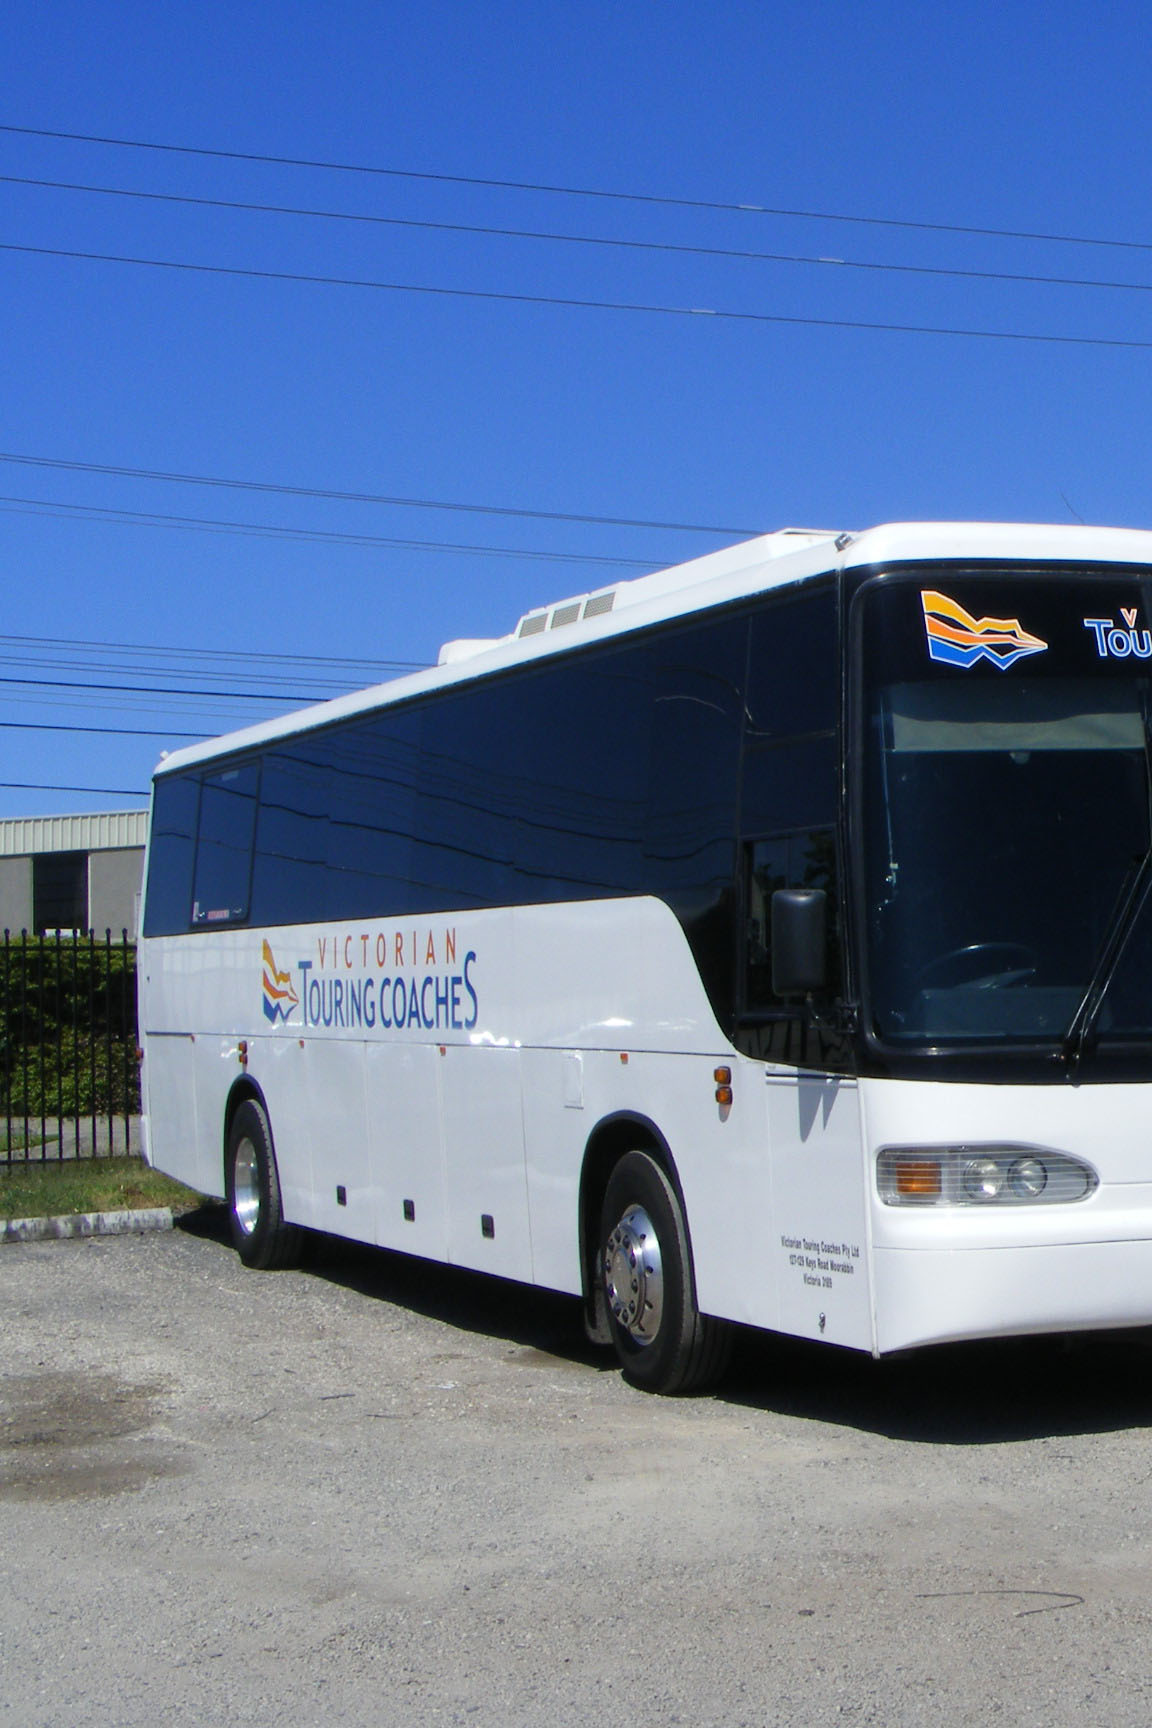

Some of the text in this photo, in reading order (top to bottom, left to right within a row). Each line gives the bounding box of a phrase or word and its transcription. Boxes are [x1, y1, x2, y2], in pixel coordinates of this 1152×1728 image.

[318, 927, 457, 970] VICTORIAN
[298, 950, 479, 1031] TOURING COACHES
[781, 1236, 860, 1259] Victorian Touring Coaches Pty Ltd
[805, 1256, 817, 1271] Keys
[817, 1258, 829, 1271] Road
[803, 1273, 821, 1287] Victoria
